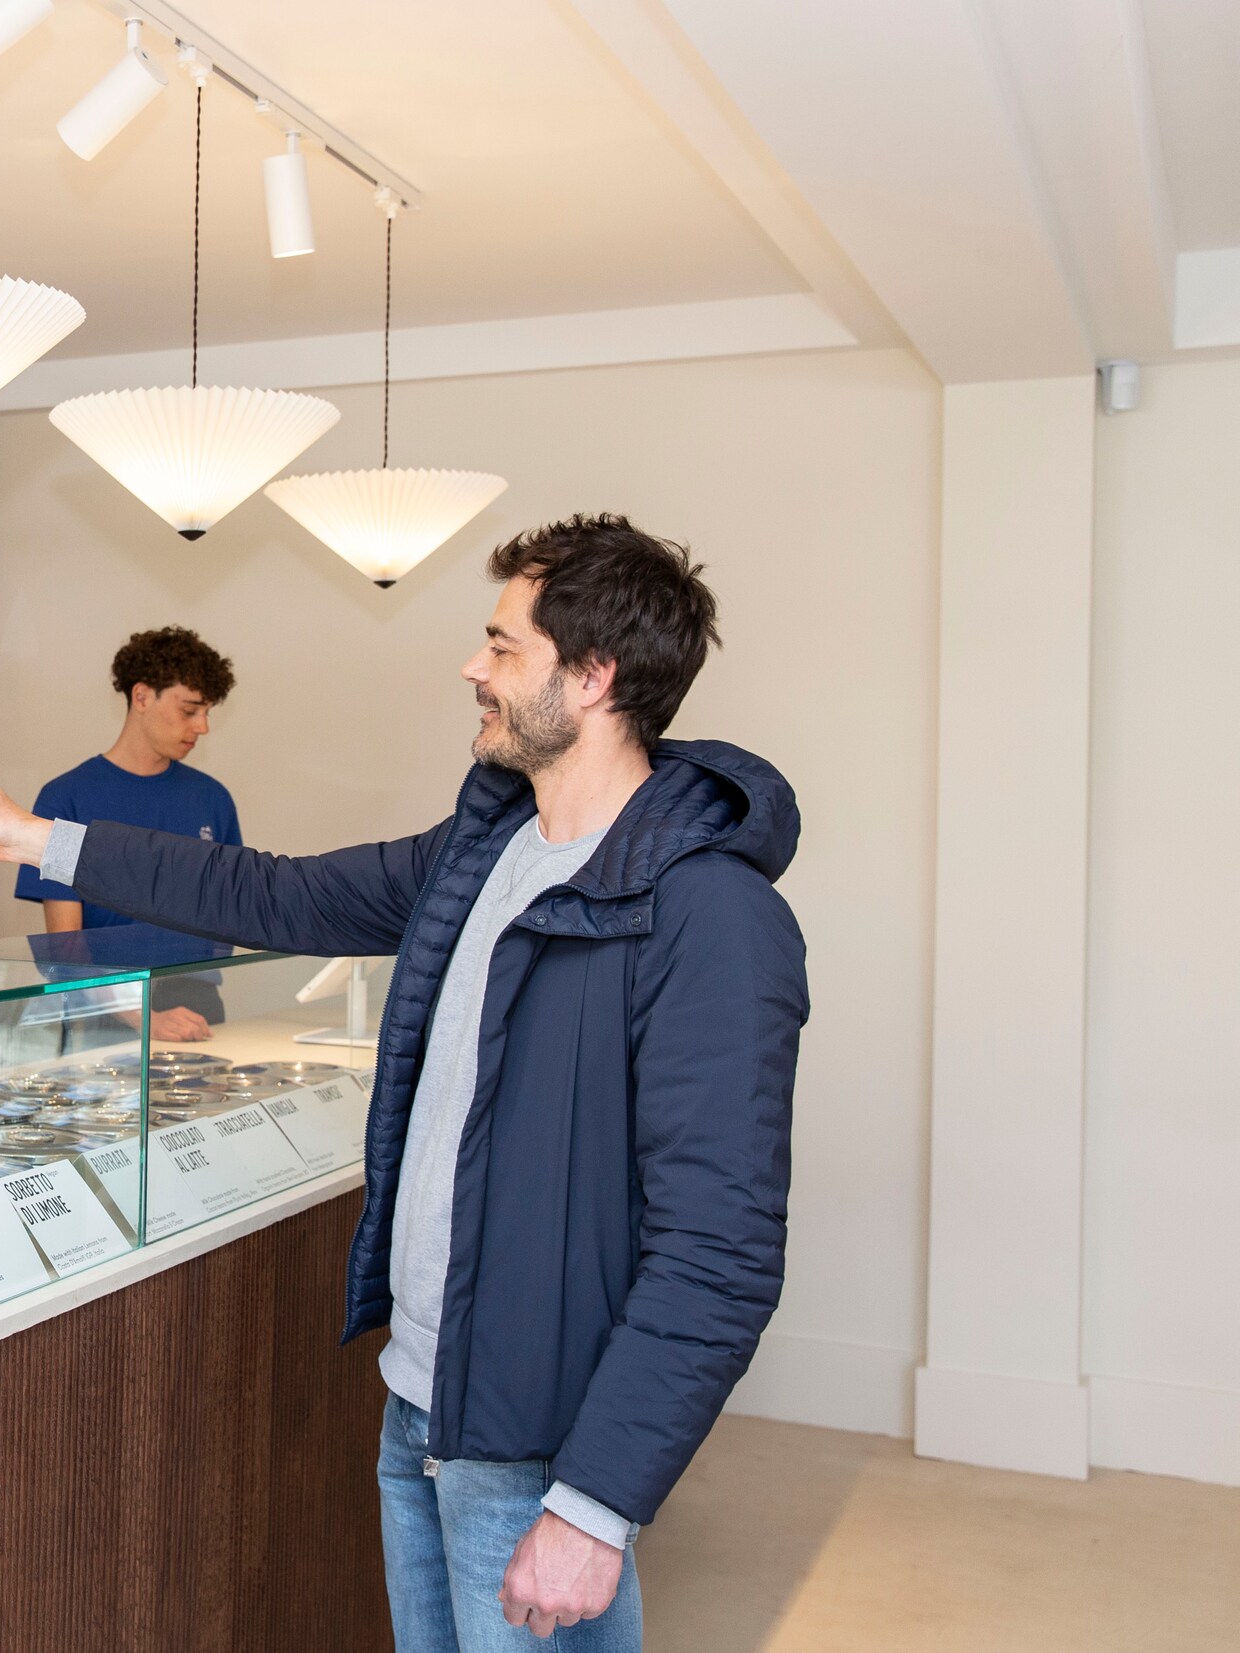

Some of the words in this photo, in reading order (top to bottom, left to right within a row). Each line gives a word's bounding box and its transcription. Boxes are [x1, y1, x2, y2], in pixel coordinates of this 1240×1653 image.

[159, 1126, 206, 1152] CIOCCOLATO
[90, 1148, 132, 1175] BURRATA
[174, 1156, 190, 1173] AL
[183, 1149, 210, 1171] LATTE
[4, 1173, 54, 1201] SORBETTO
[20, 1205, 38, 1225] DI
[31, 1195, 72, 1222] LIMONE
